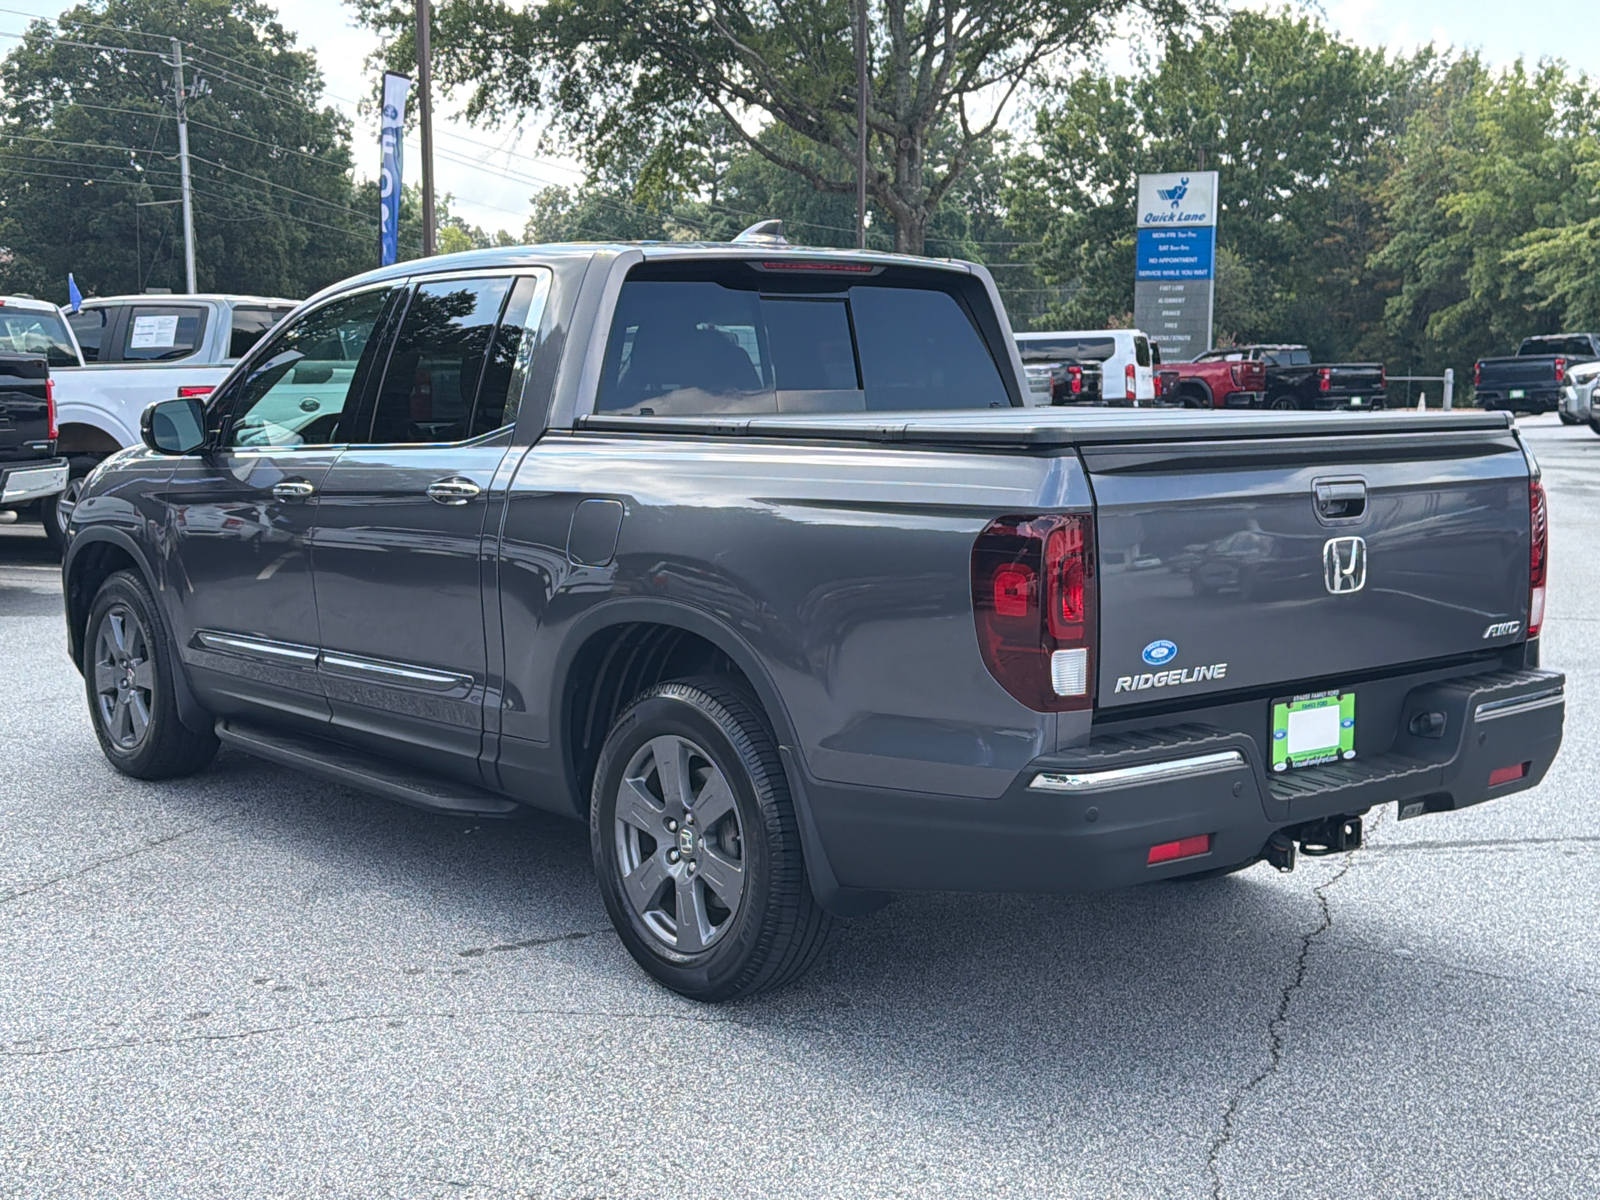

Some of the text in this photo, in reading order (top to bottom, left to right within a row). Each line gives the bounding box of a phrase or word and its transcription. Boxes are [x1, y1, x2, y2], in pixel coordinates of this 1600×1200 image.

[1144, 211, 1206, 223] Quick Lane
[1159, 256, 1198, 264] APPOINTMENT
[1114, 663, 1228, 693] RIDGELINE
